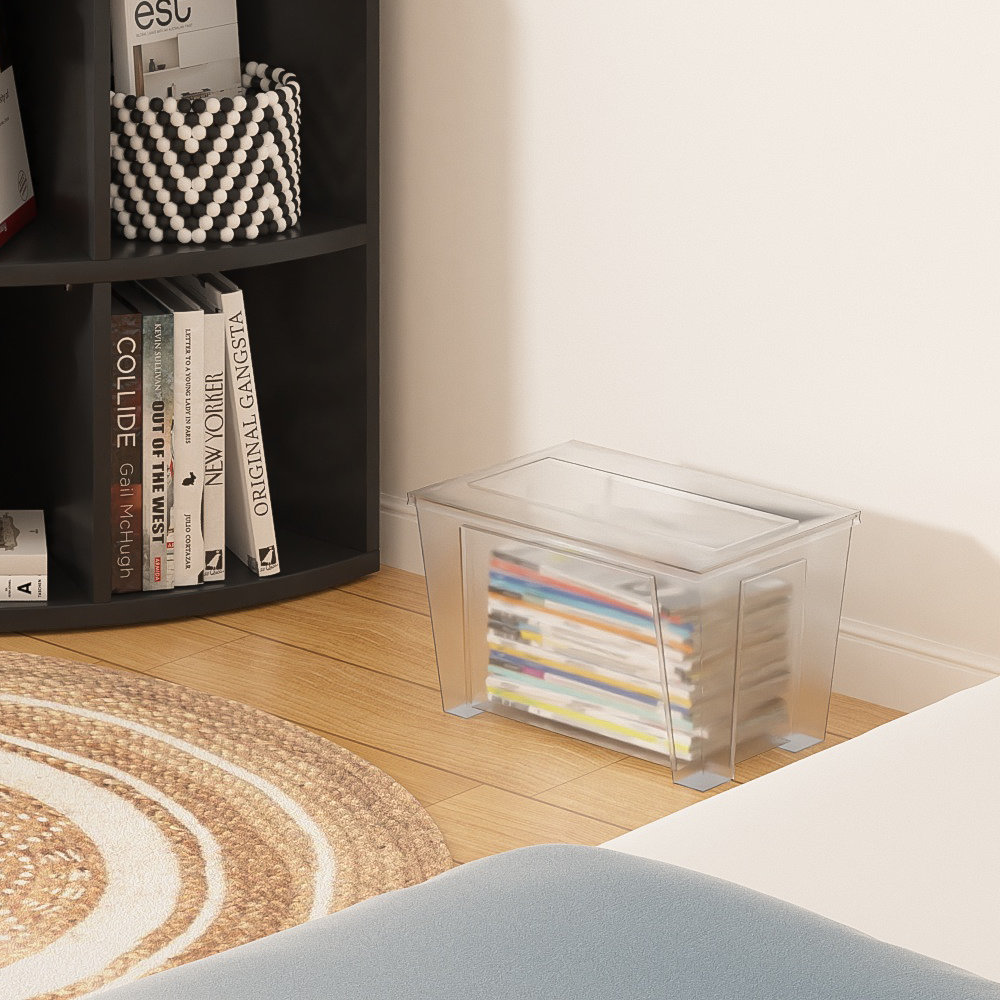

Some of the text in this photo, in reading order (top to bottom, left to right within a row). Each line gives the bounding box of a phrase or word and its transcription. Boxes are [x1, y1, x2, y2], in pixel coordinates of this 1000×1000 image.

[116, 336, 136, 449] COLLIDE
[186, 356, 191, 365] TO
[228, 310, 269, 518] ORIGINAL GANGSTA
[152, 400, 164, 543] OUT OF THE WEST
[186, 416, 191, 425] IN
[204, 371, 224, 486] NEW YORKER
[119, 463, 134, 579] Gail McHugh
[16, 582, 32, 595] A
